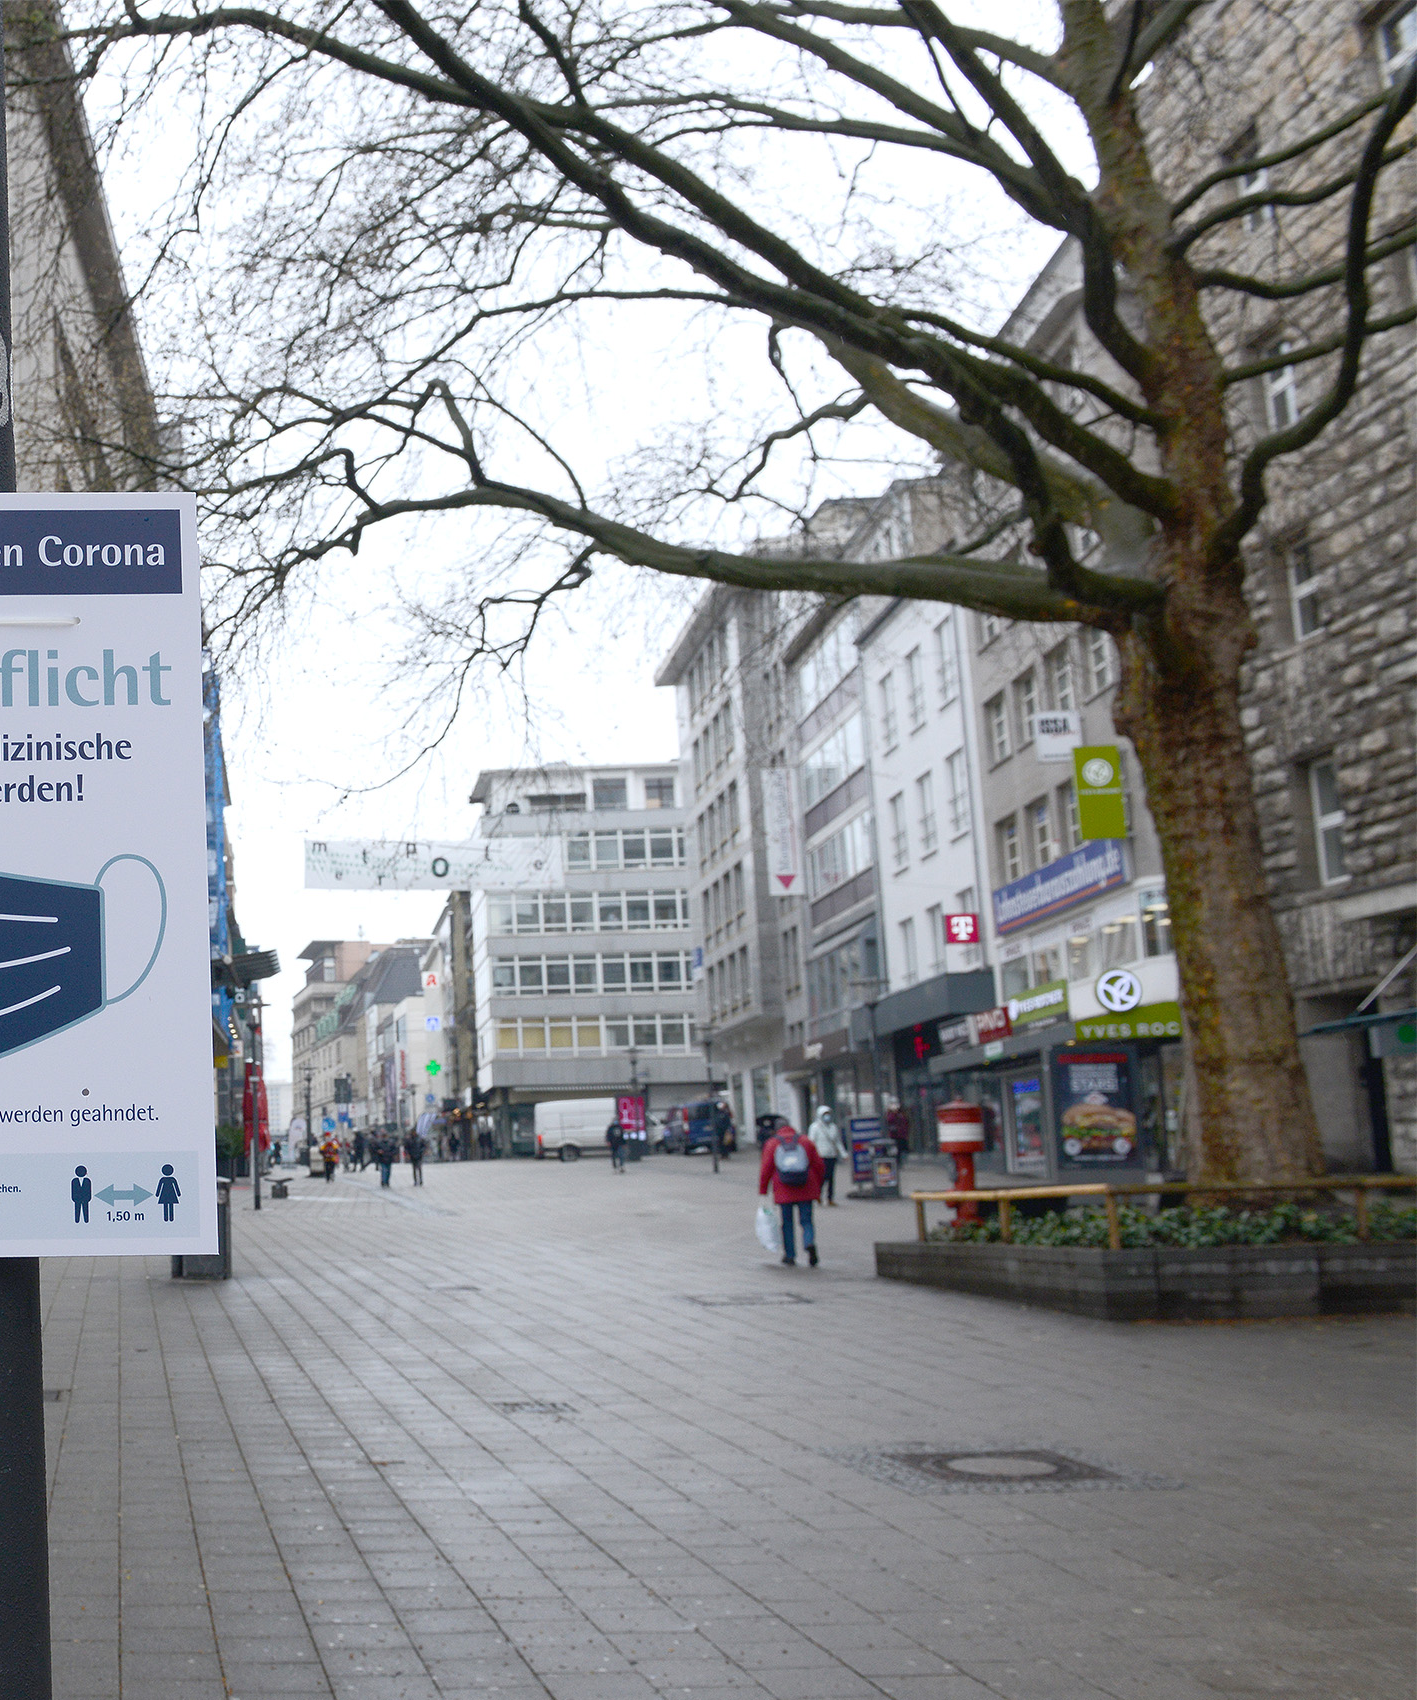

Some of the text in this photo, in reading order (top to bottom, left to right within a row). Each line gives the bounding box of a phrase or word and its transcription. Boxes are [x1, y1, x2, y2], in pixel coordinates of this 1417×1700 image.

[37, 534, 166, 567] Corona
[1082, 1024, 1131, 1039] YVES
[0, 1105, 64, 1124] werden
[69, 1103, 159, 1127] geahndet.
[105, 1211, 144, 1223] 1,50 m
